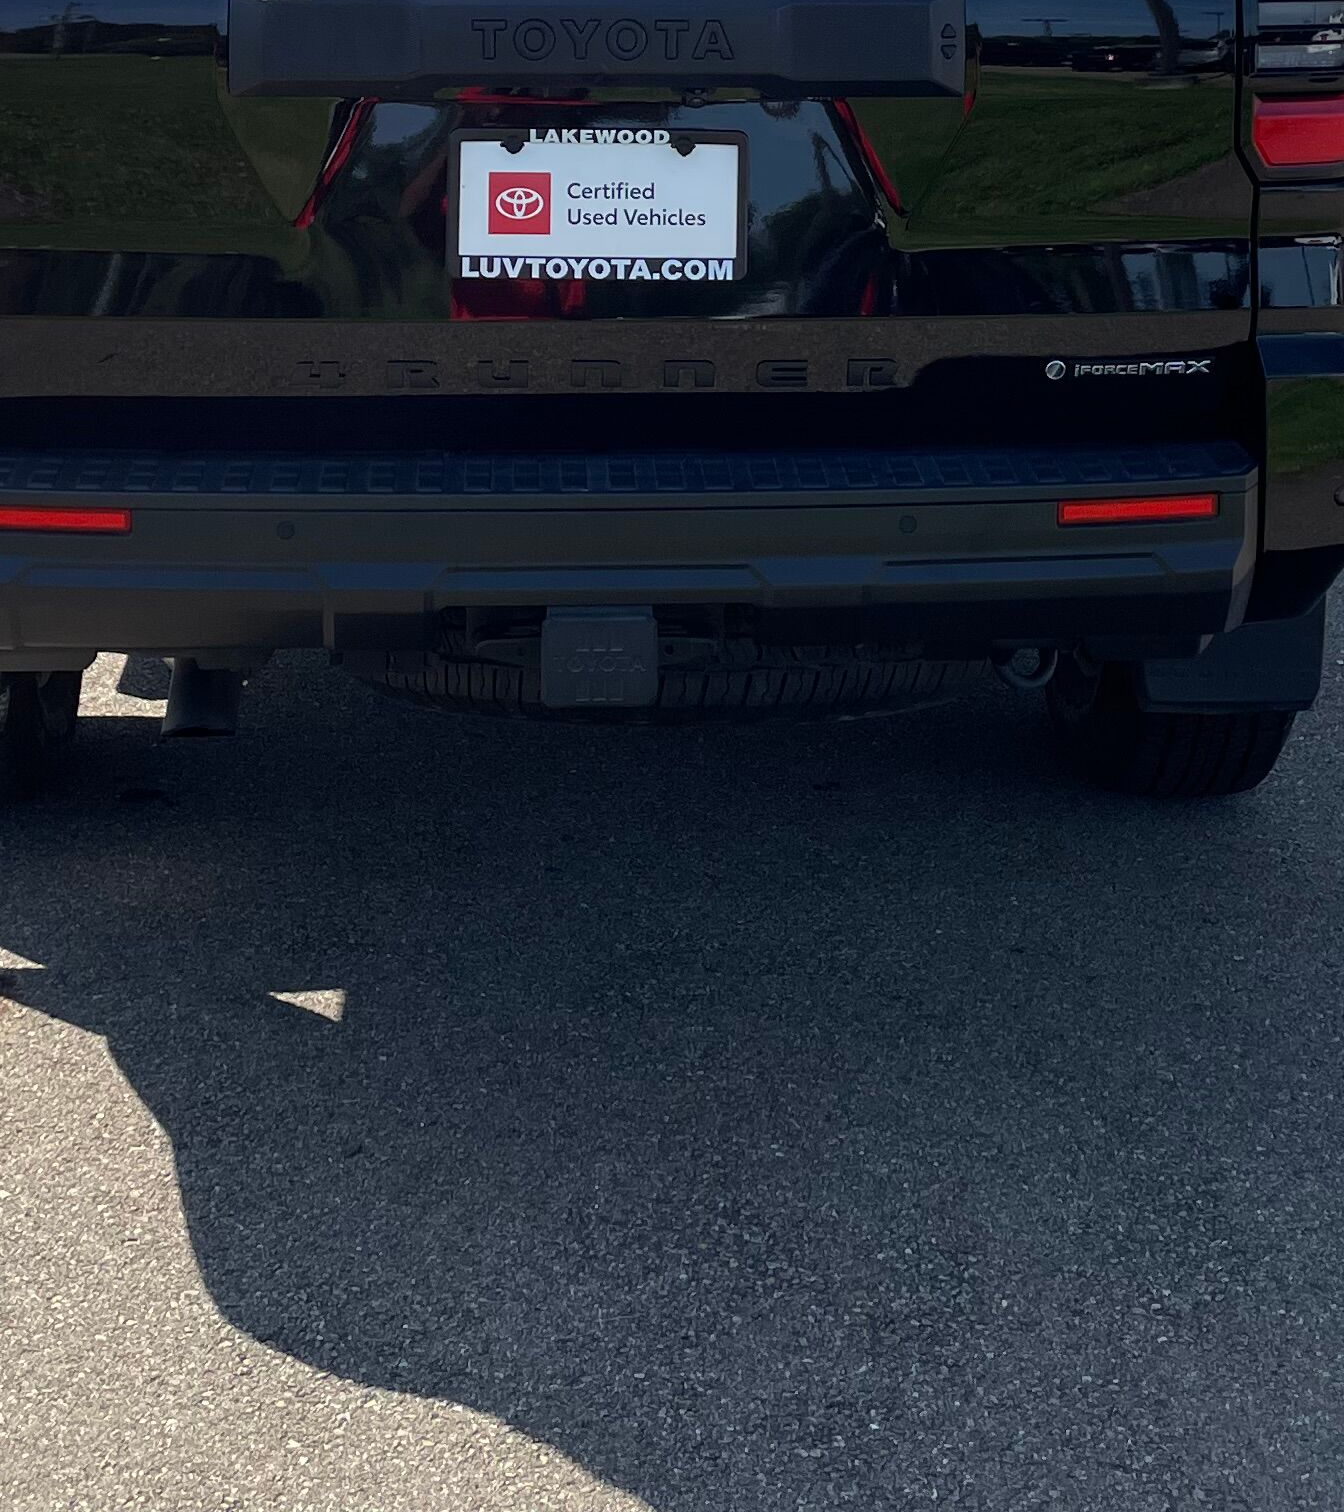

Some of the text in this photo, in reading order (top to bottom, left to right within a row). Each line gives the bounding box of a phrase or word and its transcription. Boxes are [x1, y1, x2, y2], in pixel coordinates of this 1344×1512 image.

[471, 18, 735, 61] TOYOTA
[528, 128, 671, 144] LAKEWOOD
[567, 182, 655, 200] Certified
[567, 208, 706, 226] Used Vehicles
[461, 256, 734, 281] LUVTOYOTA.COM
[290, 359, 897, 388] 4RUNNER
